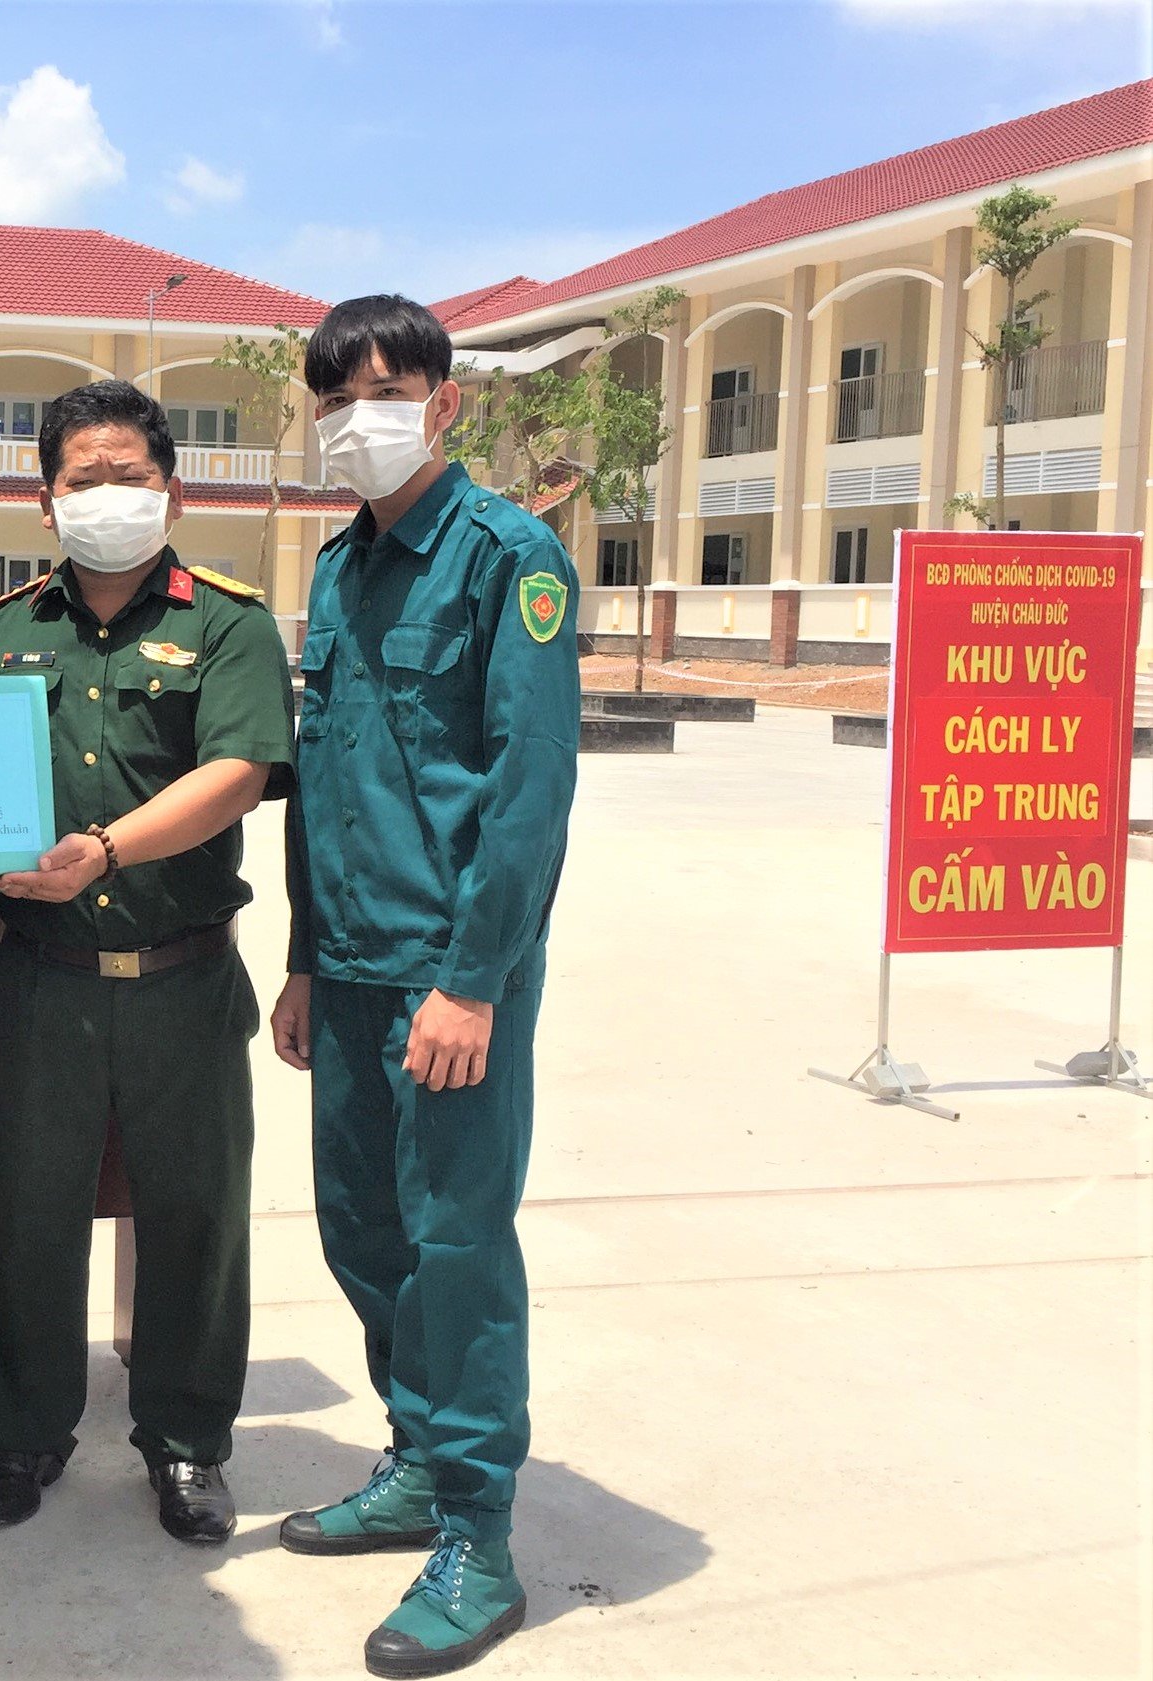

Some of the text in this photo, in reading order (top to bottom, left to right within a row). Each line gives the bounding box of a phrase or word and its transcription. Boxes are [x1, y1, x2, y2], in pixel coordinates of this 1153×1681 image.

[926, 556, 1116, 592] BCĐ PHÒNG CHỐNG DỊCH COVID-19
[971, 597, 1069, 629] HUYỆN CHÂU ĐỨC
[947, 638, 1087, 691] KHU VỰC
[944, 706, 1082, 754] CÁCH LY
[920, 774, 1099, 830] TẬP TRUNG
[908, 847, 1106, 914] CẤM VÀO
